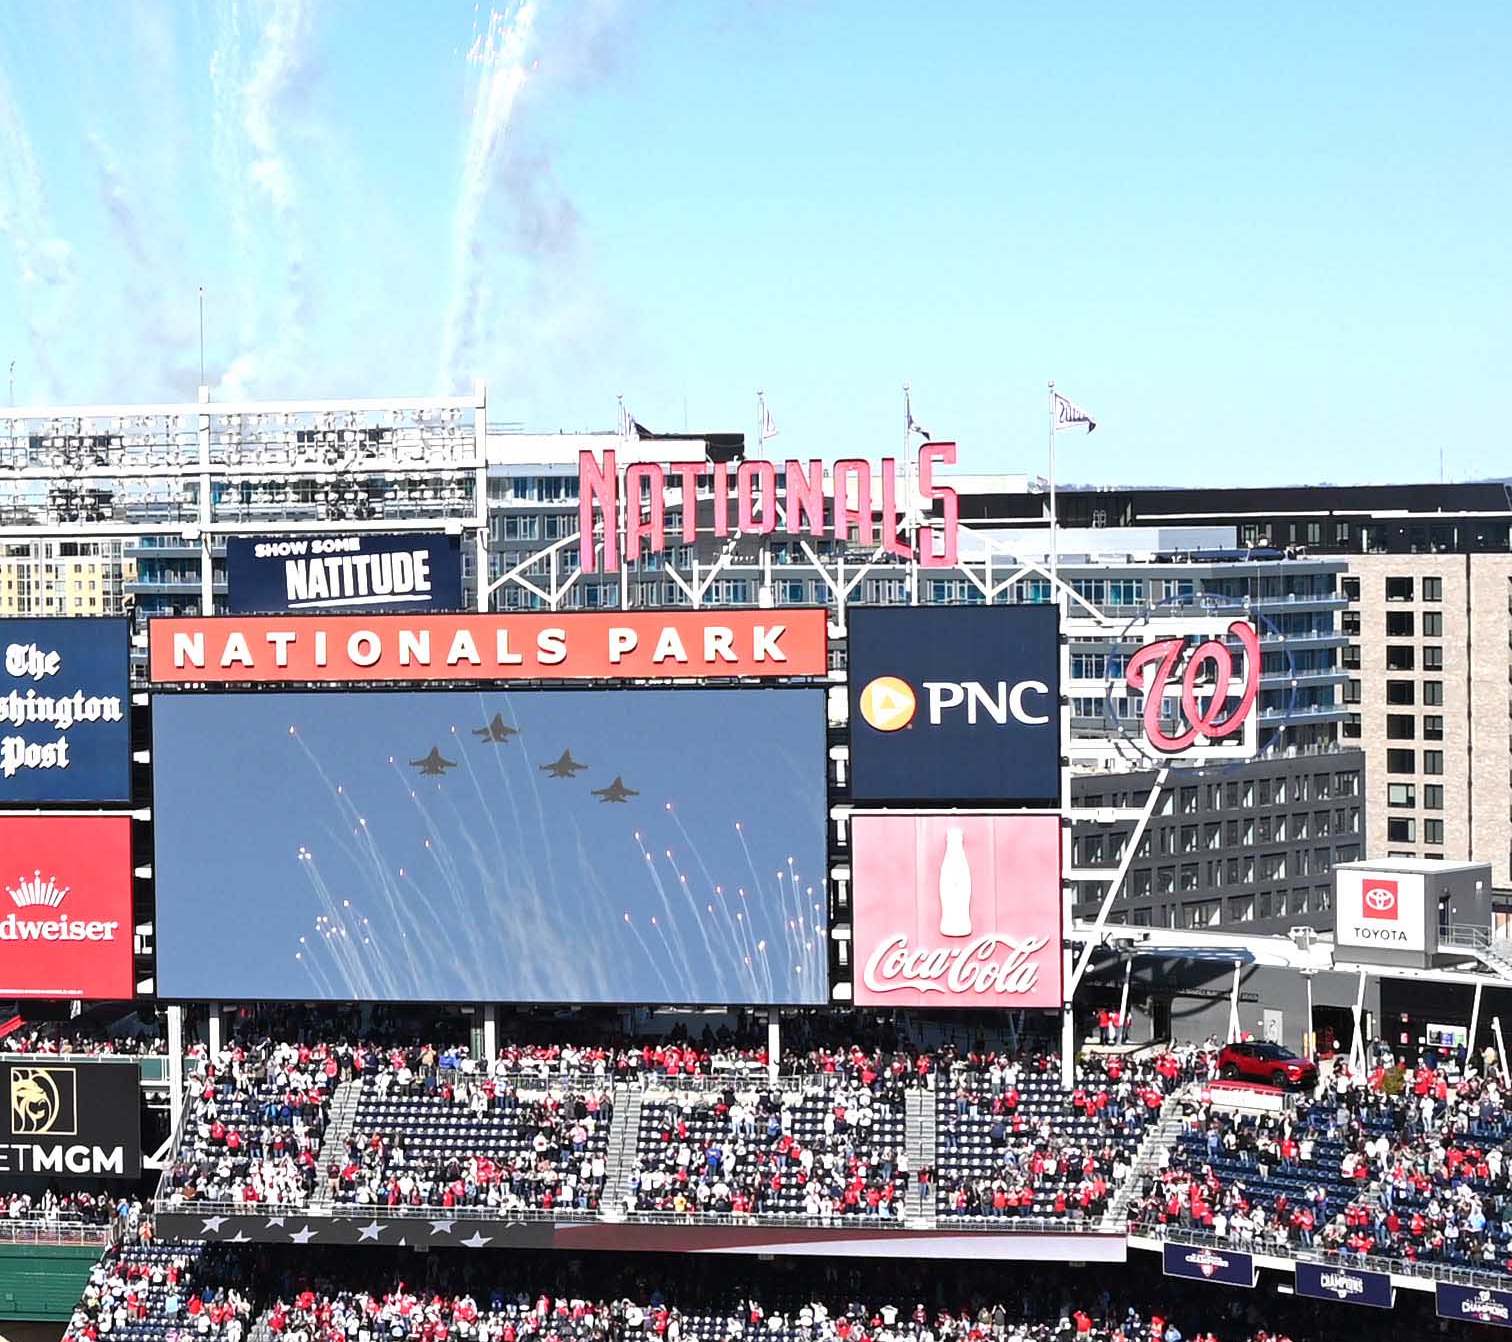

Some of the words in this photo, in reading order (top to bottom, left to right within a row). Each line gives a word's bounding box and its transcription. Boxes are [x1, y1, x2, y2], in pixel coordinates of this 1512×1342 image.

[578, 442, 958, 574] NATIONALS
[253, 541, 308, 558] SHOW
[311, 537, 361, 555] SOME
[285, 549, 433, 601] NATITUDE
[4, 642, 62, 678] The
[172, 627, 570, 669] NATIONALS
[608, 624, 790, 664] PARK
[929, 680, 1051, 727] PNC
[1353, 927, 1409, 942] TOYOTA
[862, 933, 1050, 995] Coca-Cola
